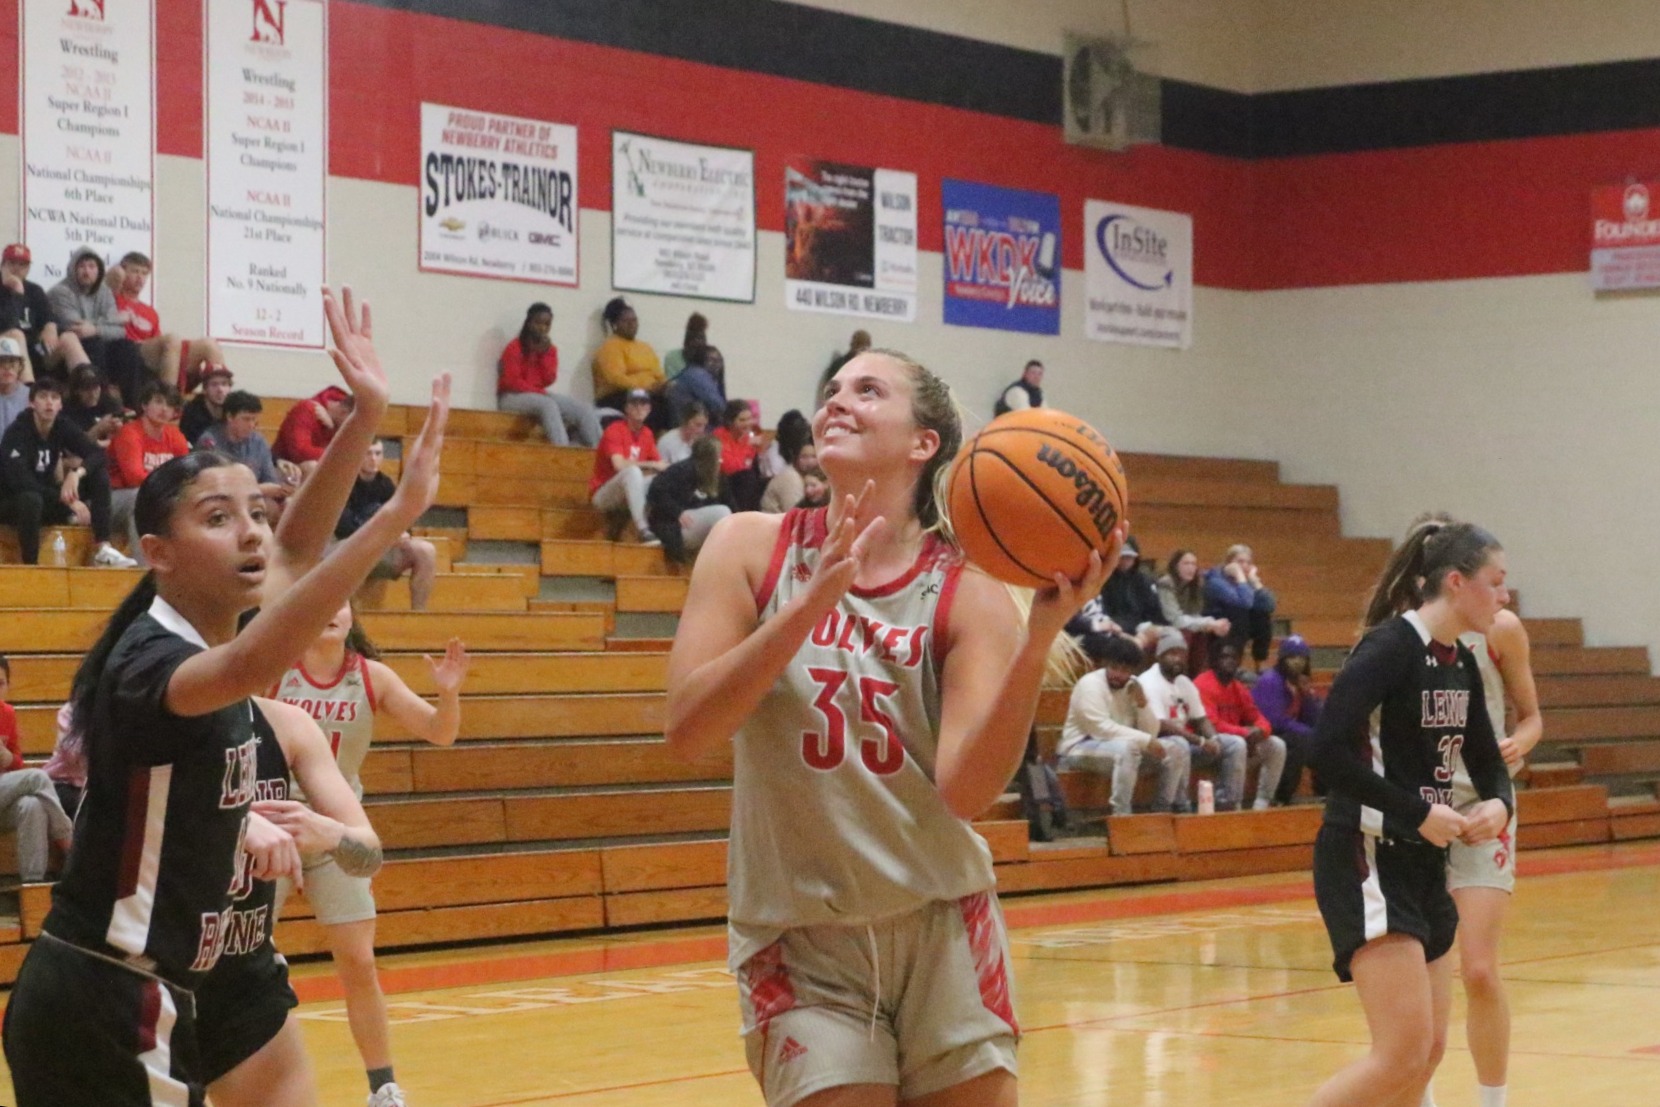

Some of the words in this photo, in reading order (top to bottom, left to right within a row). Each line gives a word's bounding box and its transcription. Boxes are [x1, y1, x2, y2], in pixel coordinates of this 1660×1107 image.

[59, 38, 119, 63] Wrestling
[242, 67, 296, 93] Wrestling
[47, 95, 80, 114] Super
[82, 99, 122, 118] Region
[56, 117, 120, 138] Champions
[247, 115, 281, 132] NCAA
[448, 111, 486, 132] PROUD
[488, 117, 536, 139] PARTNER
[538, 125, 552, 141] OF
[66, 145, 101, 161] NCAA
[231, 132, 261, 149] Super
[264, 136, 299, 153] Region
[441, 128, 500, 151] NEWBERRY
[503, 138, 559, 160] ATHLETICS
[240, 153, 297, 172] Champions
[27, 163, 71, 181] National
[73, 169, 151, 192] Championships
[64, 188, 82, 201] 6th
[85, 189, 114, 204] Place
[247, 190, 281, 205] NCAA
[425, 151, 573, 234] STOKES-TRAINOR
[28, 207, 66, 224] NCWA
[69, 211, 118, 228] National
[120, 216, 150, 232] Duals
[210, 204, 252, 221] National
[254, 210, 324, 231] Championships
[64, 227, 82, 241] 5th
[85, 229, 114, 244] Place
[243, 226, 263, 240] 21st
[265, 228, 292, 243] Place
[528, 231, 562, 247] GMC
[1113, 223, 1168, 258] InSite
[945, 224, 1040, 286] WKDK
[249, 263, 287, 279] Ranked
[256, 279, 308, 298] Nationally
[815, 289, 846, 310] WILSON
[864, 295, 908, 317] NEWBERRY
[232, 324, 267, 337] Season
[269, 326, 304, 341] Record
[810, 606, 930, 670] OLVES
[801, 666, 906, 776] 35
